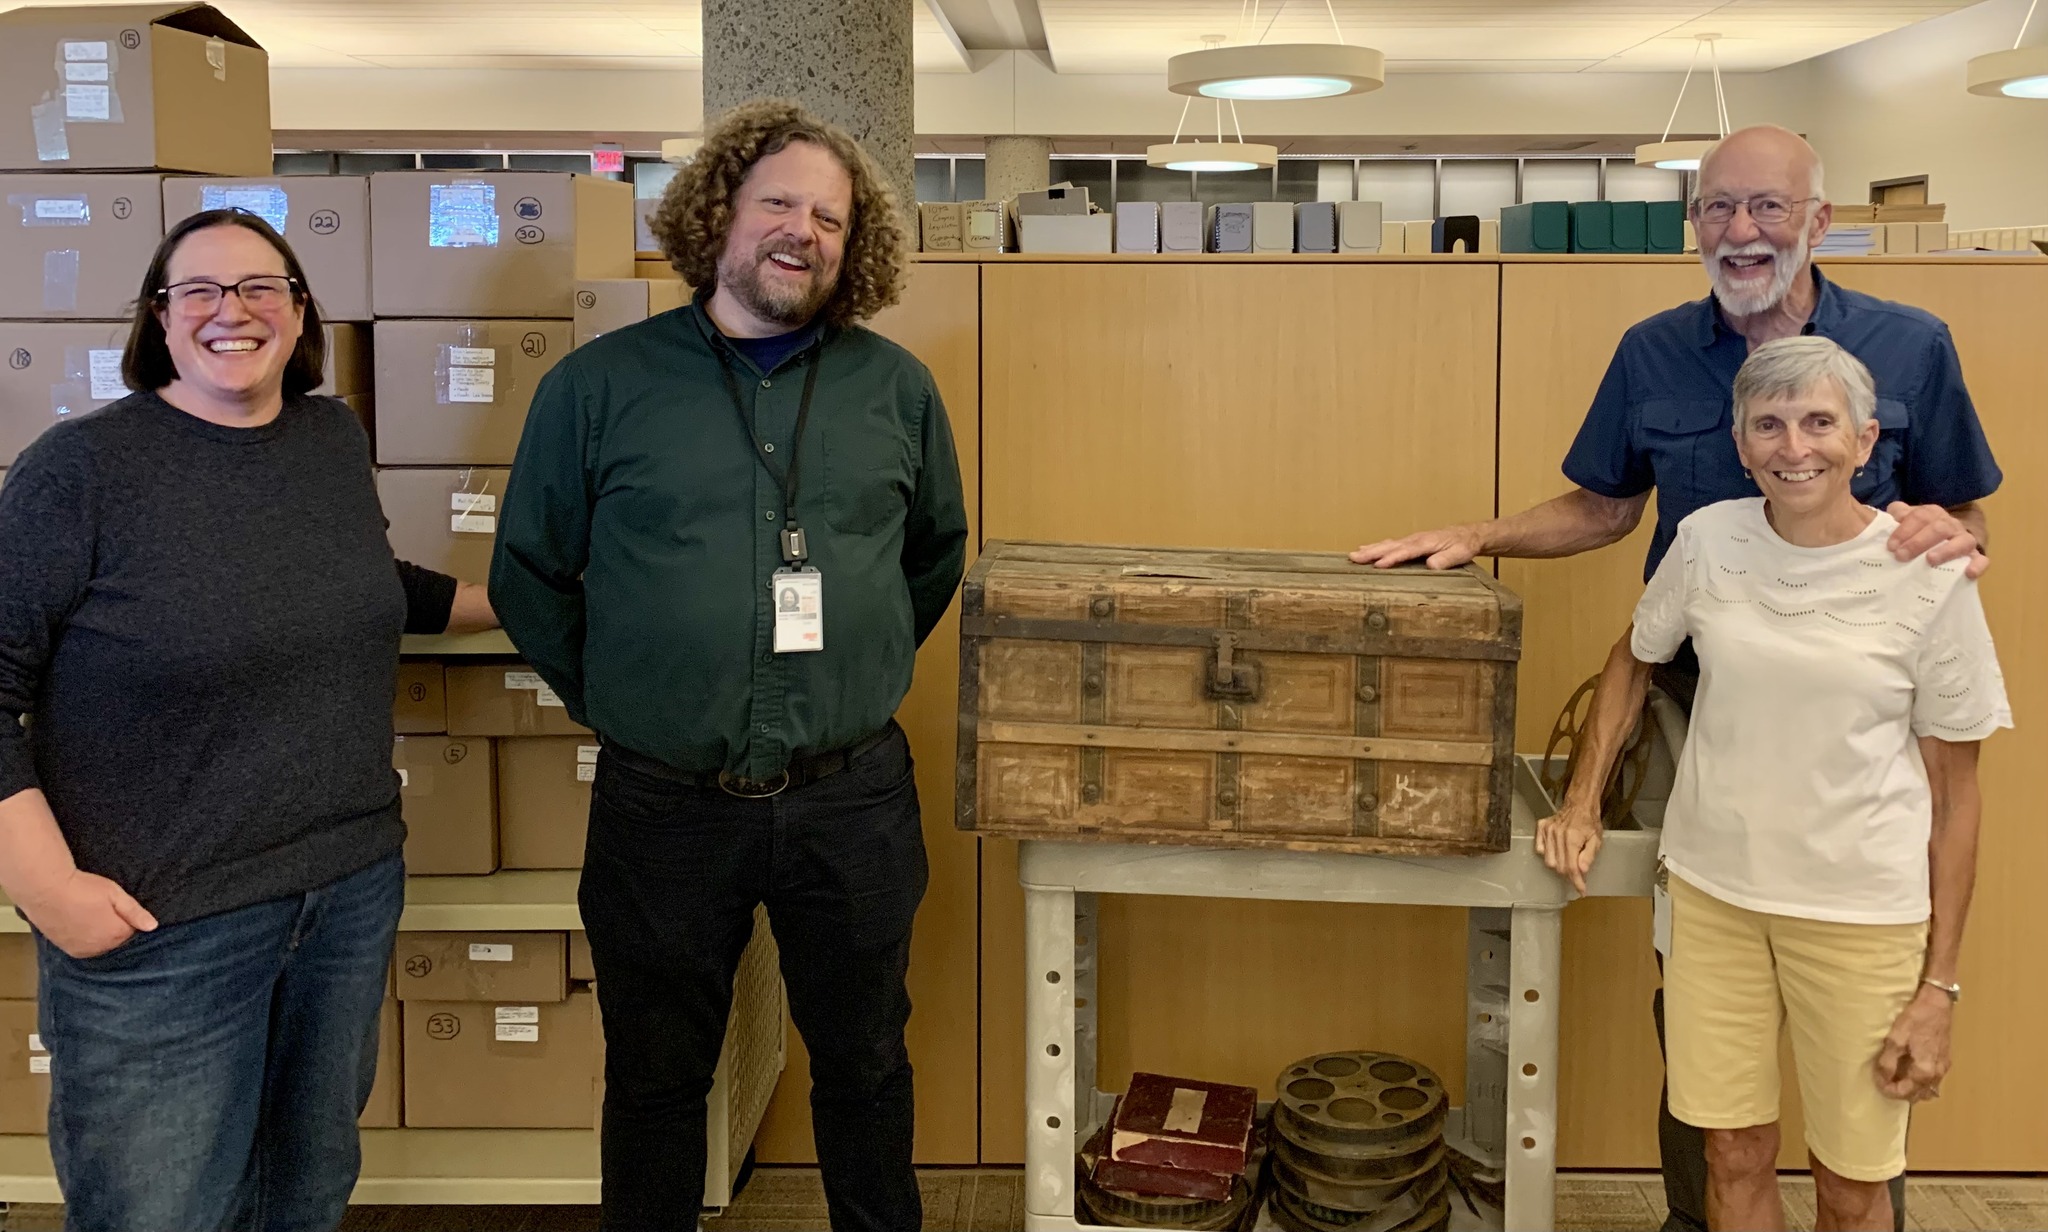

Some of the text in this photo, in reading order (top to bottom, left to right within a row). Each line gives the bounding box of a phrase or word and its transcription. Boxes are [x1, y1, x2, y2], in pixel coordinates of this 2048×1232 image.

[596, 151, 622, 166] EXIT
[406, 960, 429, 975] 24
[431, 1017, 455, 1034] 33
